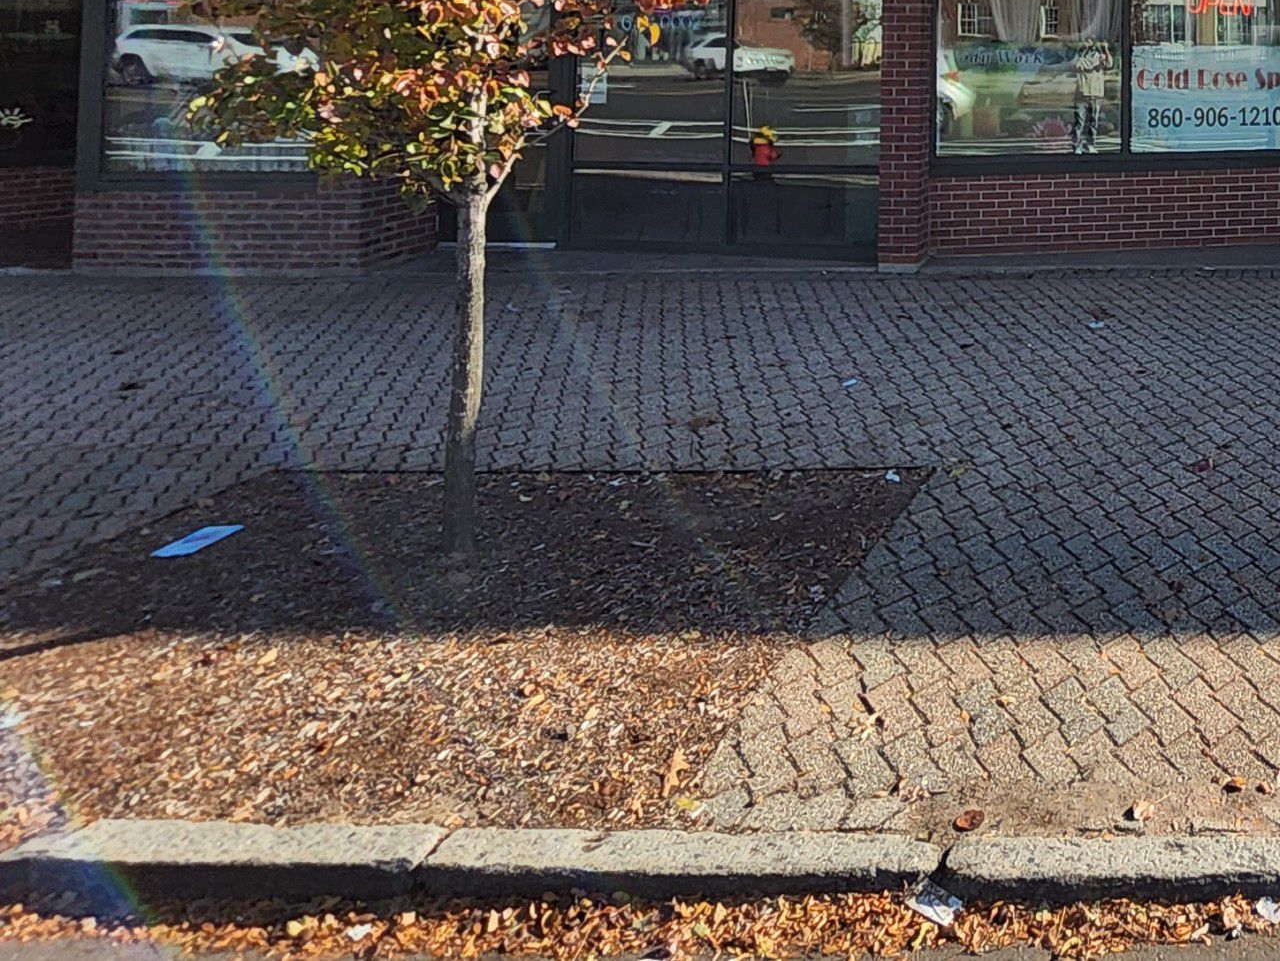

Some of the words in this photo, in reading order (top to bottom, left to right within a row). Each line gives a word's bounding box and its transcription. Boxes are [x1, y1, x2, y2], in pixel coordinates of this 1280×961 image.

[995, 46, 1045, 66] Work
[1136, 68, 1190, 91] Gold
[1198, 68, 1248, 90] Rose
